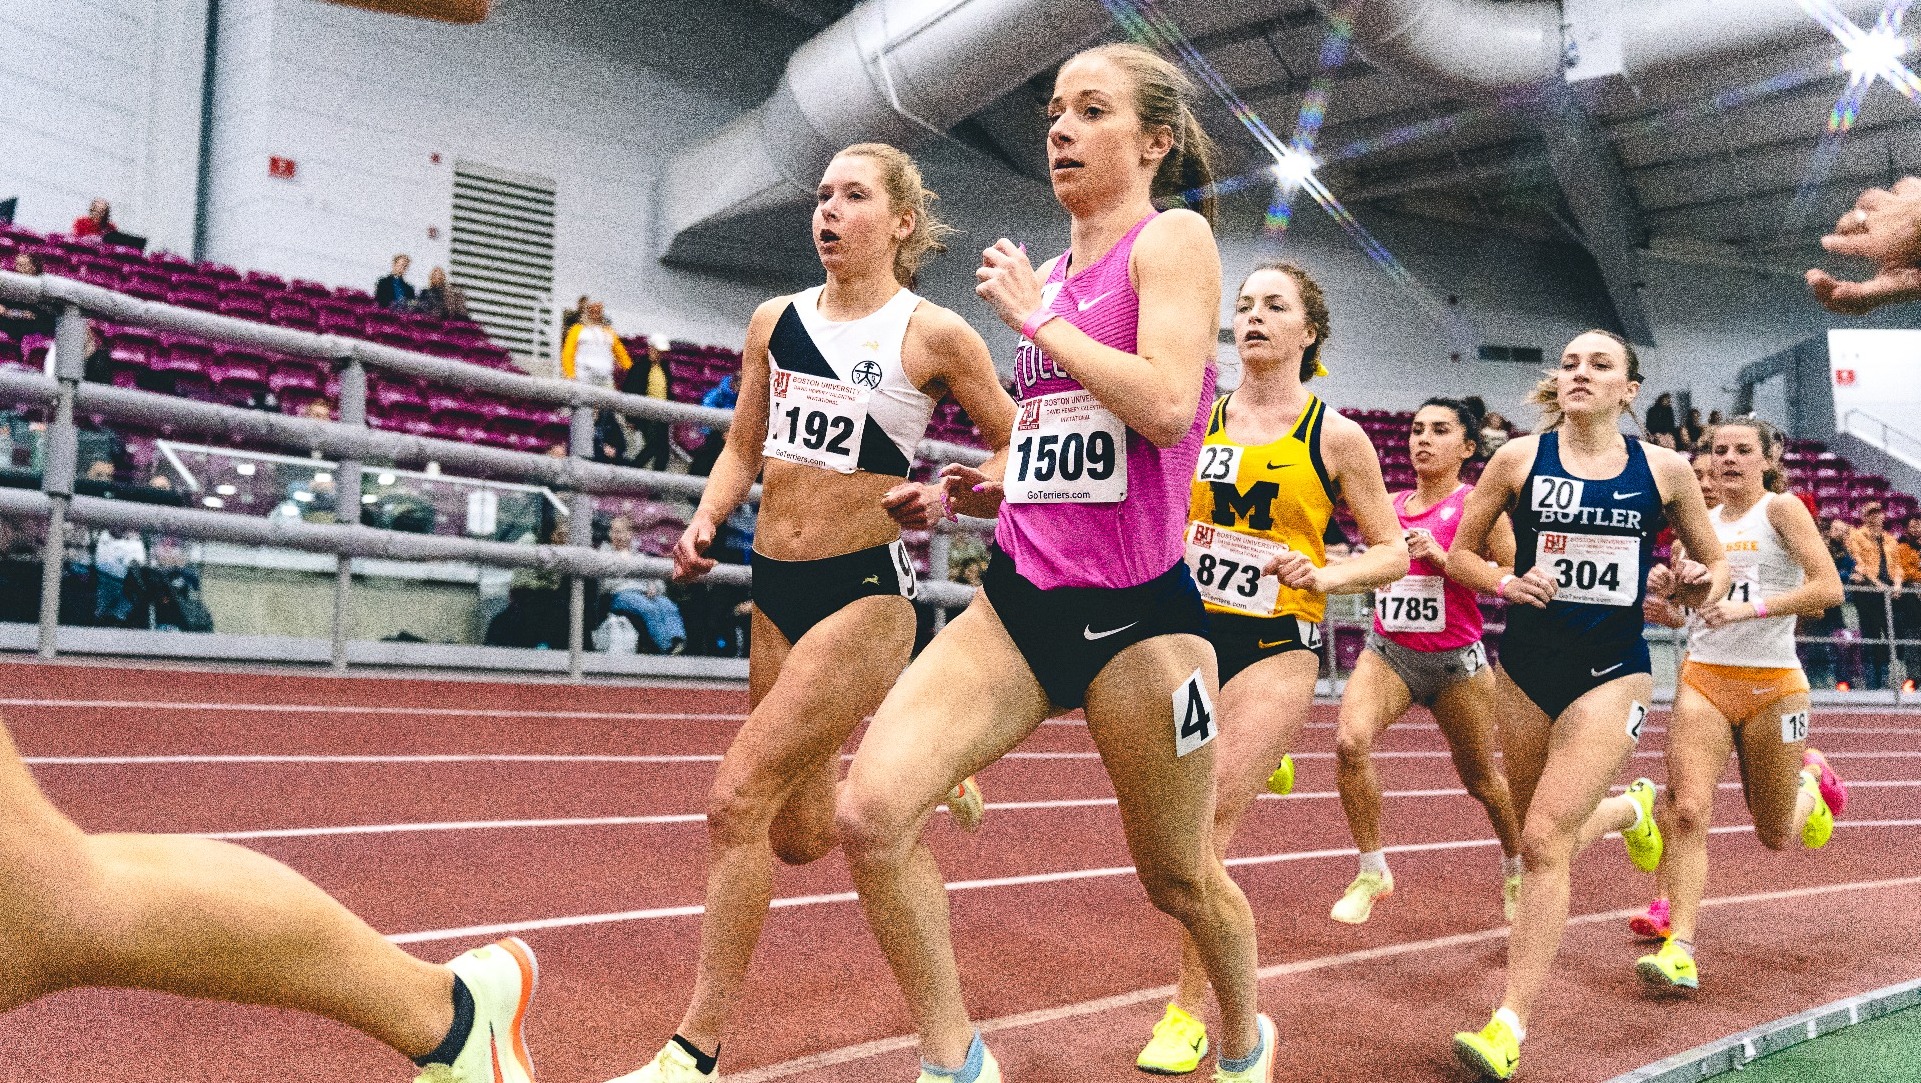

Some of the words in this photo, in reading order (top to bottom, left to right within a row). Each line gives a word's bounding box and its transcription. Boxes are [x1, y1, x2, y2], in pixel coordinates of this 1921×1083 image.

[793, 376, 820, 387] BOSTON
[821, 382, 861, 396] UNIVERSITY
[1044, 396, 1070, 407] BOSTON
[1071, 394, 1096, 404] UNIVER
[772, 402, 854, 456] 192
[776, 449, 826, 466] GoTerriers.com
[1017, 430, 1116, 482] 1509
[1200, 447, 1234, 480] 23
[1027, 490, 1091, 500] GoTerriers.com
[1210, 481, 1280, 531] M
[1538, 478, 1574, 510] 20
[1539, 507, 1642, 529] BUTLER
[1216, 531, 1242, 543] BOSTON
[1242, 537, 1280, 551] UNIVERSITY
[1196, 553, 1261, 598] 873
[1554, 558, 1620, 592] 304
[1378, 596, 1439, 622] 1785
[1180, 677, 1211, 742] 4
[1789, 712, 1805, 740] 18
